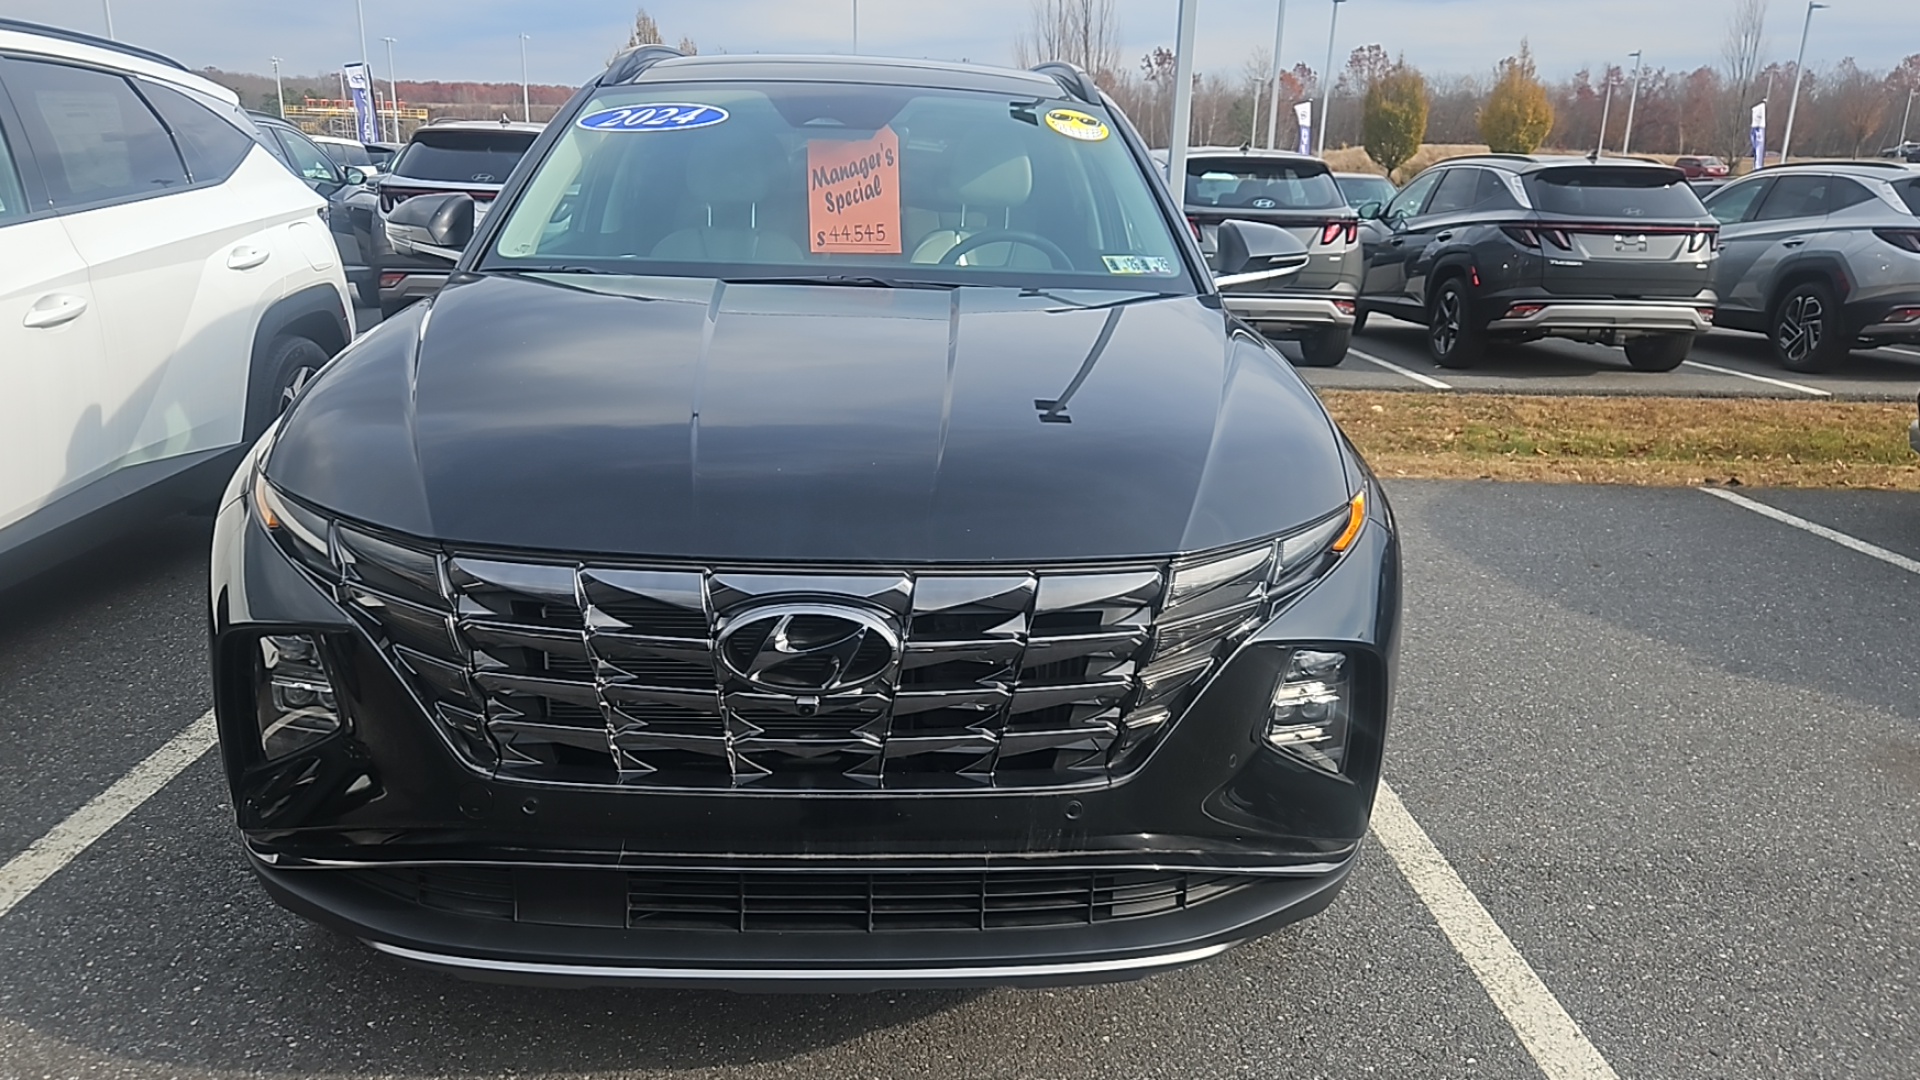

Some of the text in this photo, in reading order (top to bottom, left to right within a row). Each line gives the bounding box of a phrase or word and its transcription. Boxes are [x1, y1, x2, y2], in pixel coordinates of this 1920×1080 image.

[596, 107, 708, 127] 2024
[812, 143, 894, 191] Manager's
[825, 174, 882, 215] Special
